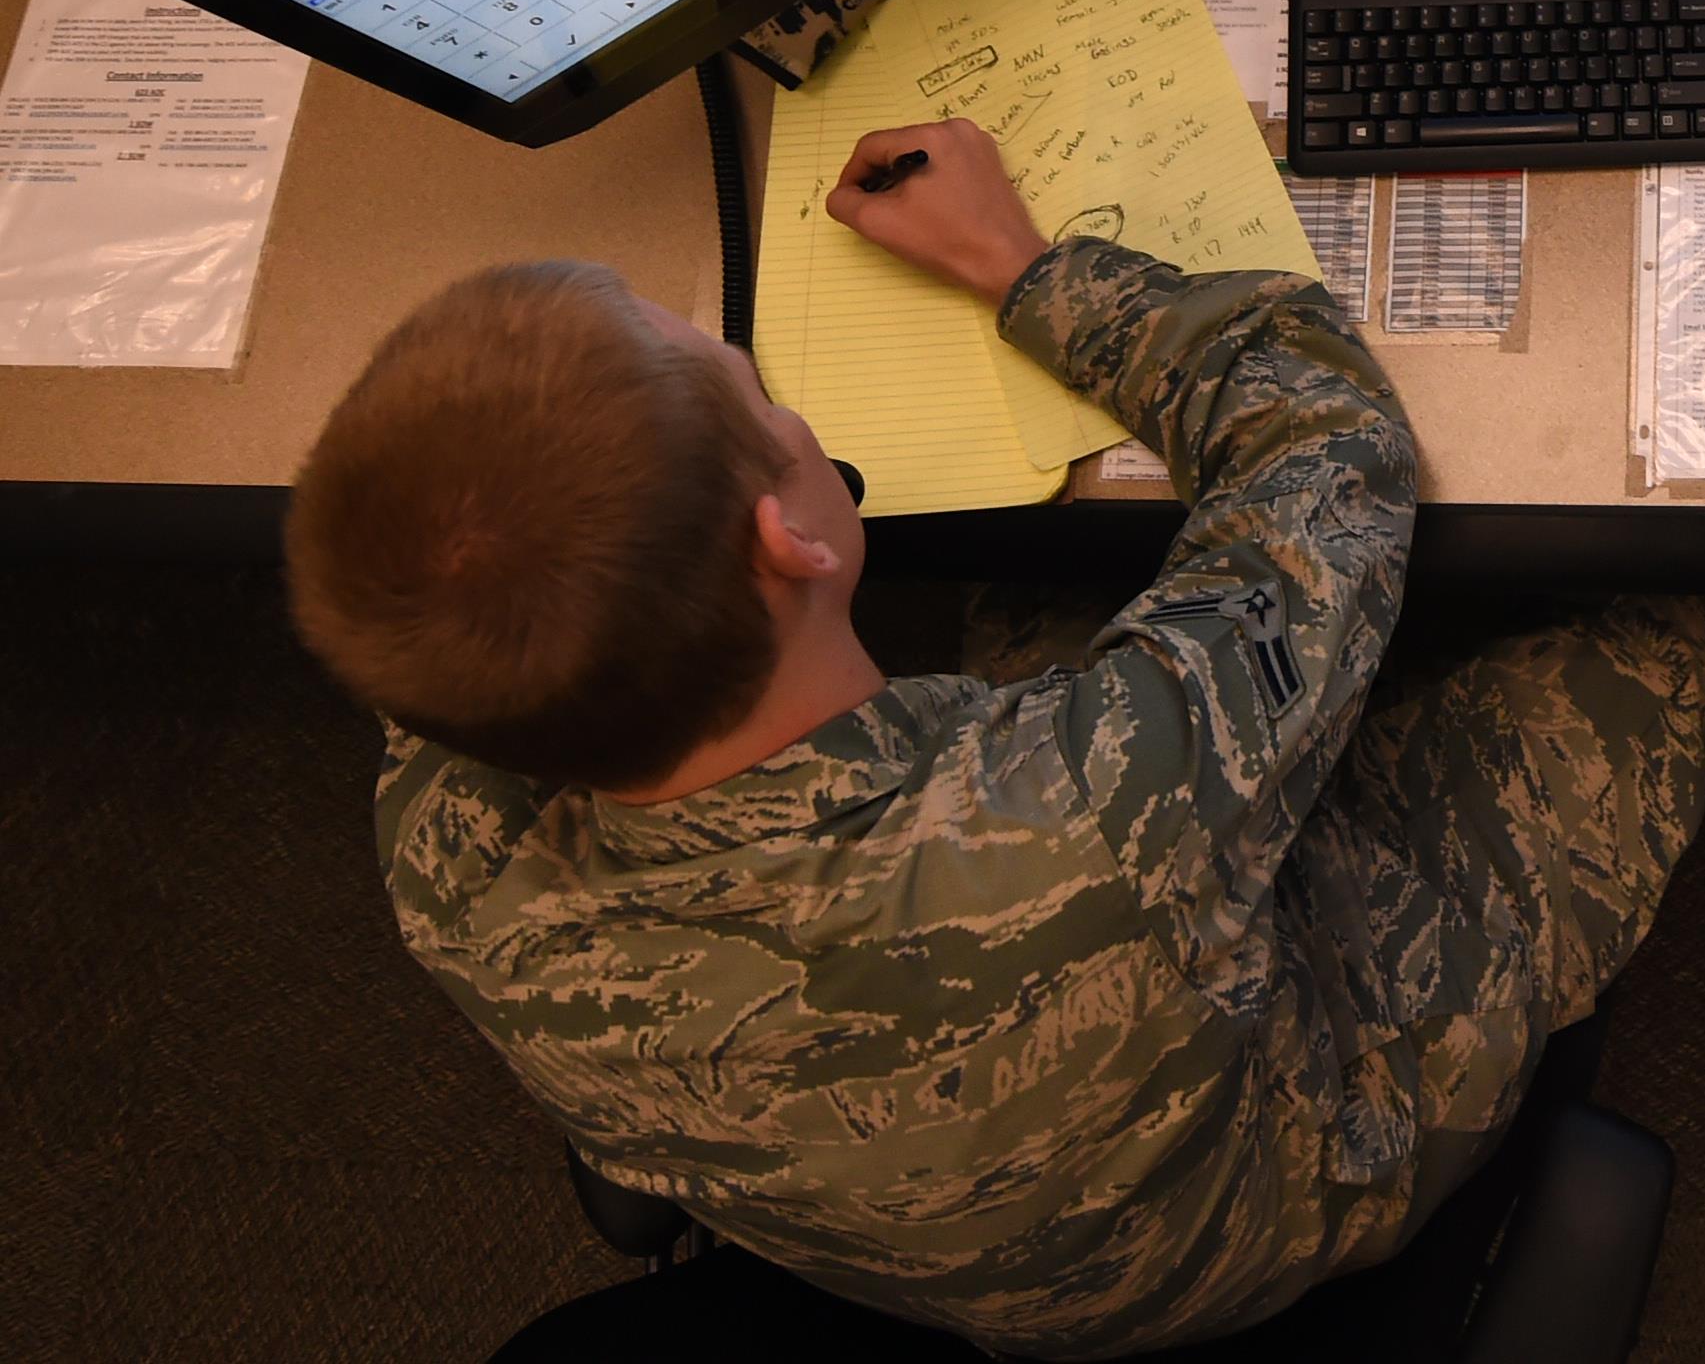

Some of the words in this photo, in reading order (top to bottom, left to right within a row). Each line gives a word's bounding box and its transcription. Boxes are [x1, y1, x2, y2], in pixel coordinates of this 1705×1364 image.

[378, 2, 398, 13] 1
[500, 1, 520, 12] 8
[410, 19, 432, 31] 4
[526, 15, 546, 27] 0
[442, 36, 462, 47] 7
[106, 71, 144, 81] Contact
[146, 71, 203, 81] Information
[1108, 70, 1138, 88] EOD
